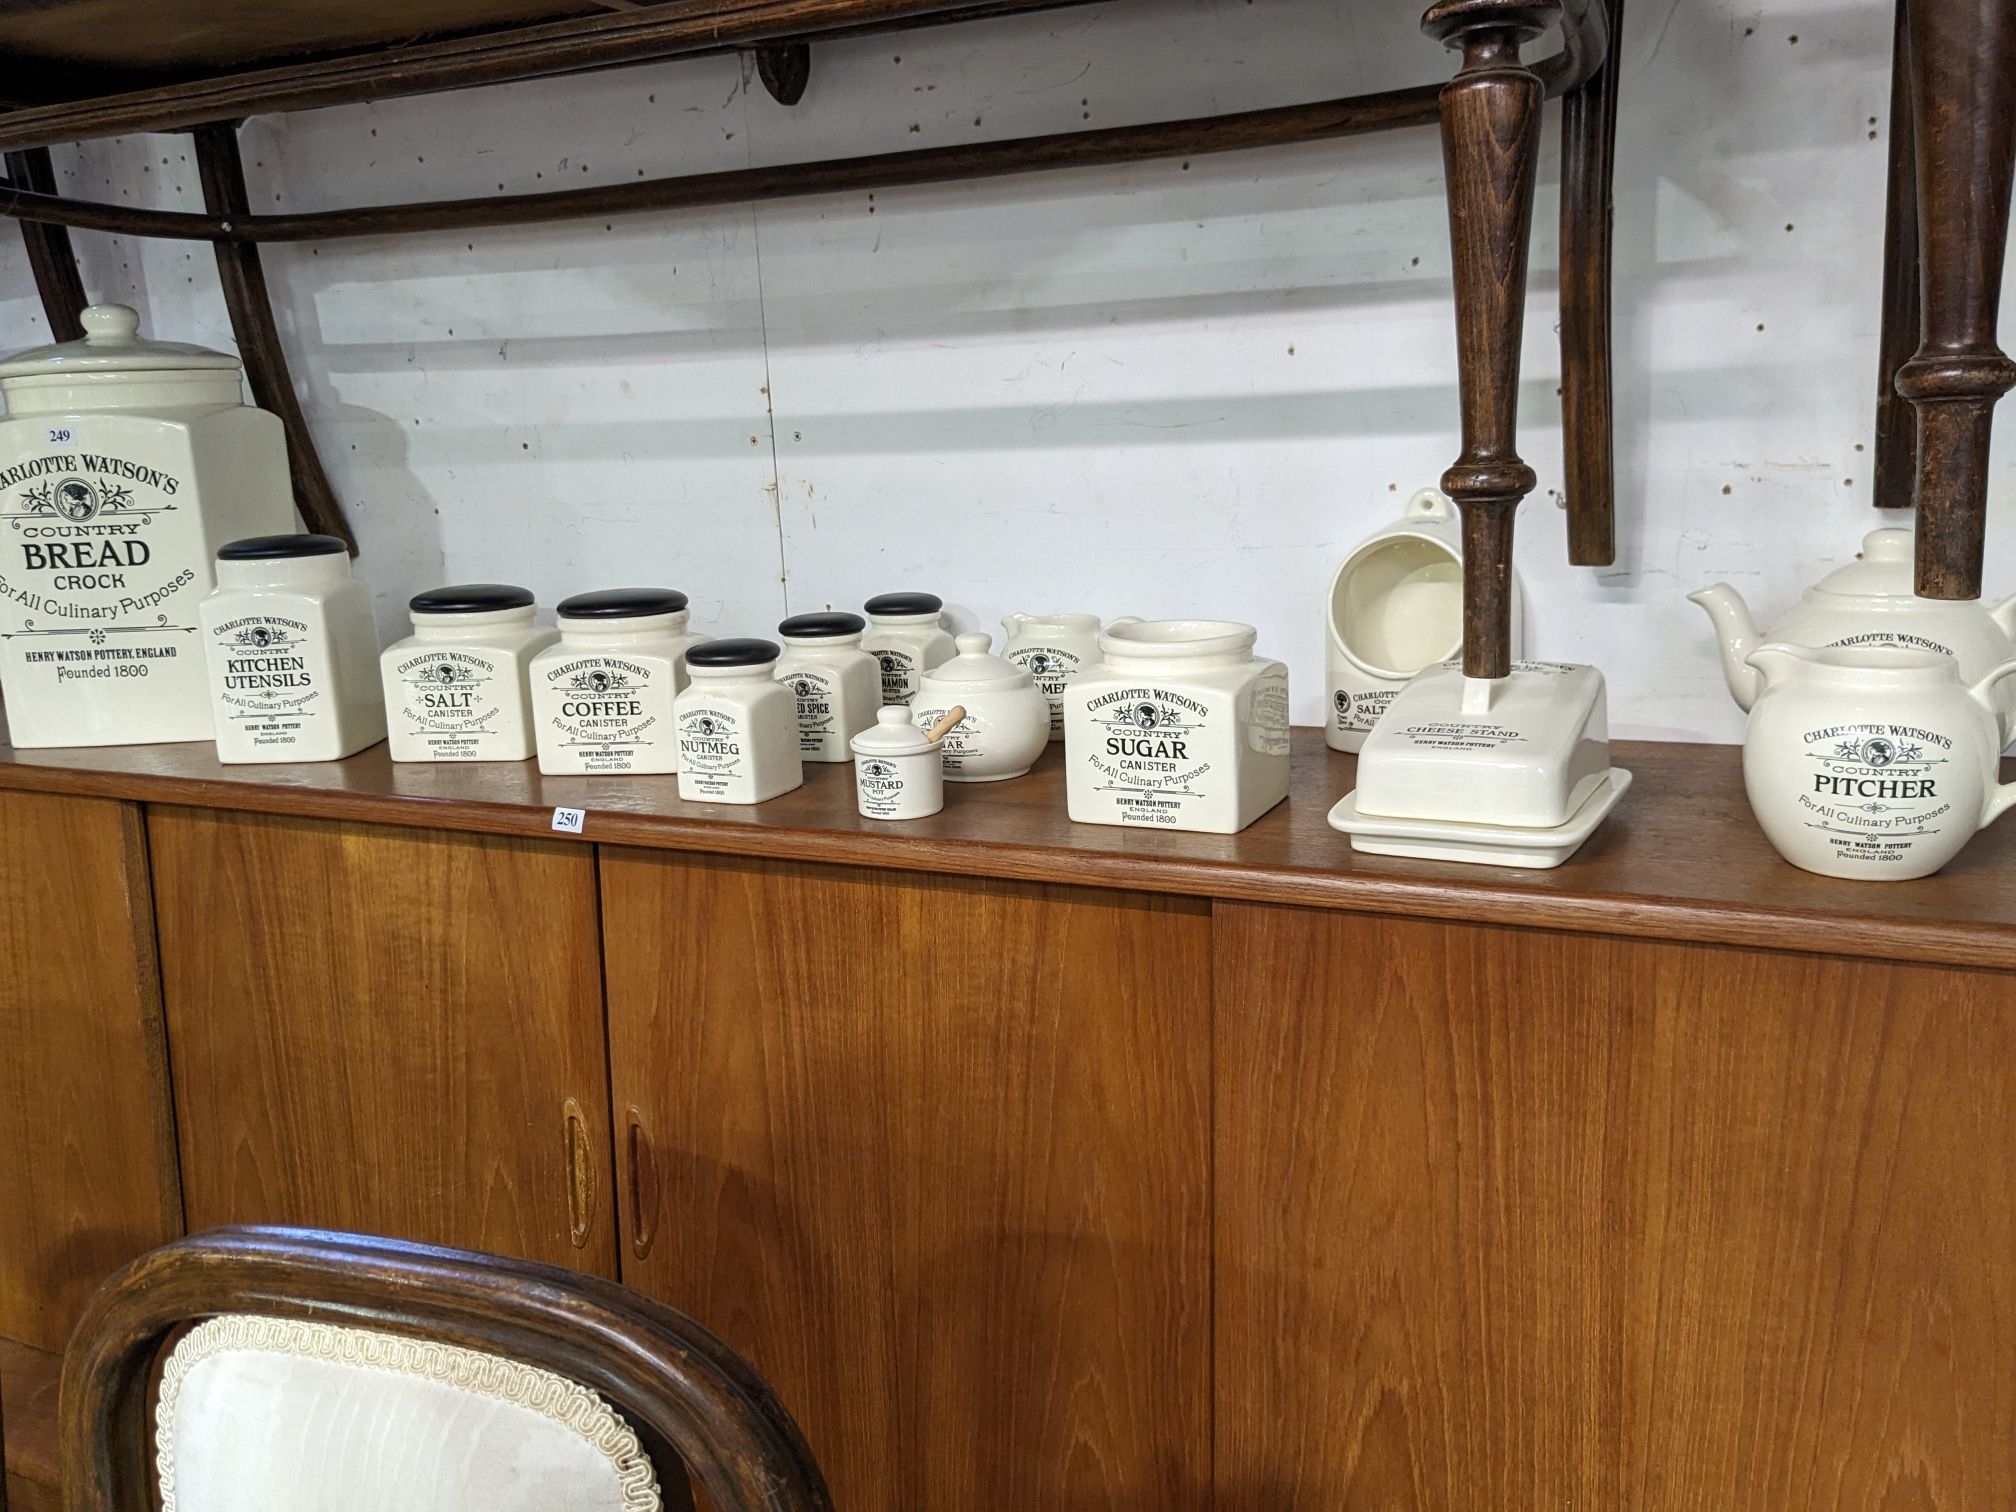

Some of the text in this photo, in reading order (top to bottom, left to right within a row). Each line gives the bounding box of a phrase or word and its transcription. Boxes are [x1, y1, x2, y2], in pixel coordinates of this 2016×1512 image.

[50, 430, 70, 442] 249
[0, 454, 179, 495] ARLOTTE WATSON'S
[24, 524, 140, 538] COUNTRY
[21, 540, 150, 570] BREAD
[54, 574, 125, 590] CROCK
[15, 590, 40, 610] All
[44, 599, 117, 619] Culinary
[120, 569, 195, 614] Purposes
[214, 617, 308, 636] CHARLOTTE WATSON'S
[1825, 633, 1893, 647] ARLOTTE
[25, 647, 176, 662] HENRY WATSON POTTERY, ENGLAND
[1009, 648, 1080, 664] CHARLOTTE WATSON'S
[228, 657, 304, 673] KITCHEN
[398, 652, 494, 674] CHARLOTTE WATSON'S
[547, 658, 650, 681] CHARLOTTE WATSON'S
[57, 665, 148, 682] Founded 1800
[224, 673, 311, 689] UTENSILS
[882, 678, 908, 688] NAMON
[221, 691, 319, 710] For All Culinary Purposes
[425, 693, 472, 707] SALT
[1087, 689, 1209, 717] CHARLOTTE WATSON'S
[562, 701, 642, 717] COFFEE
[808, 703, 829, 713] SPICE
[918, 710, 946, 718] CHARLOTTE
[1357, 705, 1386, 715] SALT
[403, 707, 499, 730] For All Culinary Purposes
[579, 719, 627, 727] CANISTER
[680, 710, 708, 722] CHARLOTTE
[1353, 713, 1364, 723] For
[552, 716, 656, 741] For All Culinary Purposes
[1113, 729, 1182, 738] COUNTRY
[1470, 729, 1519, 737] STAND
[1888, 725, 1952, 750] WATSON'S
[680, 740, 740, 755] NUTMEG
[1106, 738, 1189, 759] SUGAR
[585, 763, 612, 771] Founded
[1088, 754, 1211, 788] For All Culinary Purposes
[1120, 760, 1177, 772] CANISTER
[1832, 766, 1922, 776] COUNTRY
[860, 778, 903, 789] MUSTARD
[1814, 774, 1937, 798] PITCHER
[1158, 801, 1181, 809] POTTERY
[1799, 794, 1950, 828] For All Culinary Purposes
[557, 811, 578, 827] 250
[1122, 812, 1176, 823] Founded 1800
[1830, 839, 1851, 847] HENRY
[1855, 841, 1881, 849] WATSON
[1837, 850, 1875, 861] Founded
